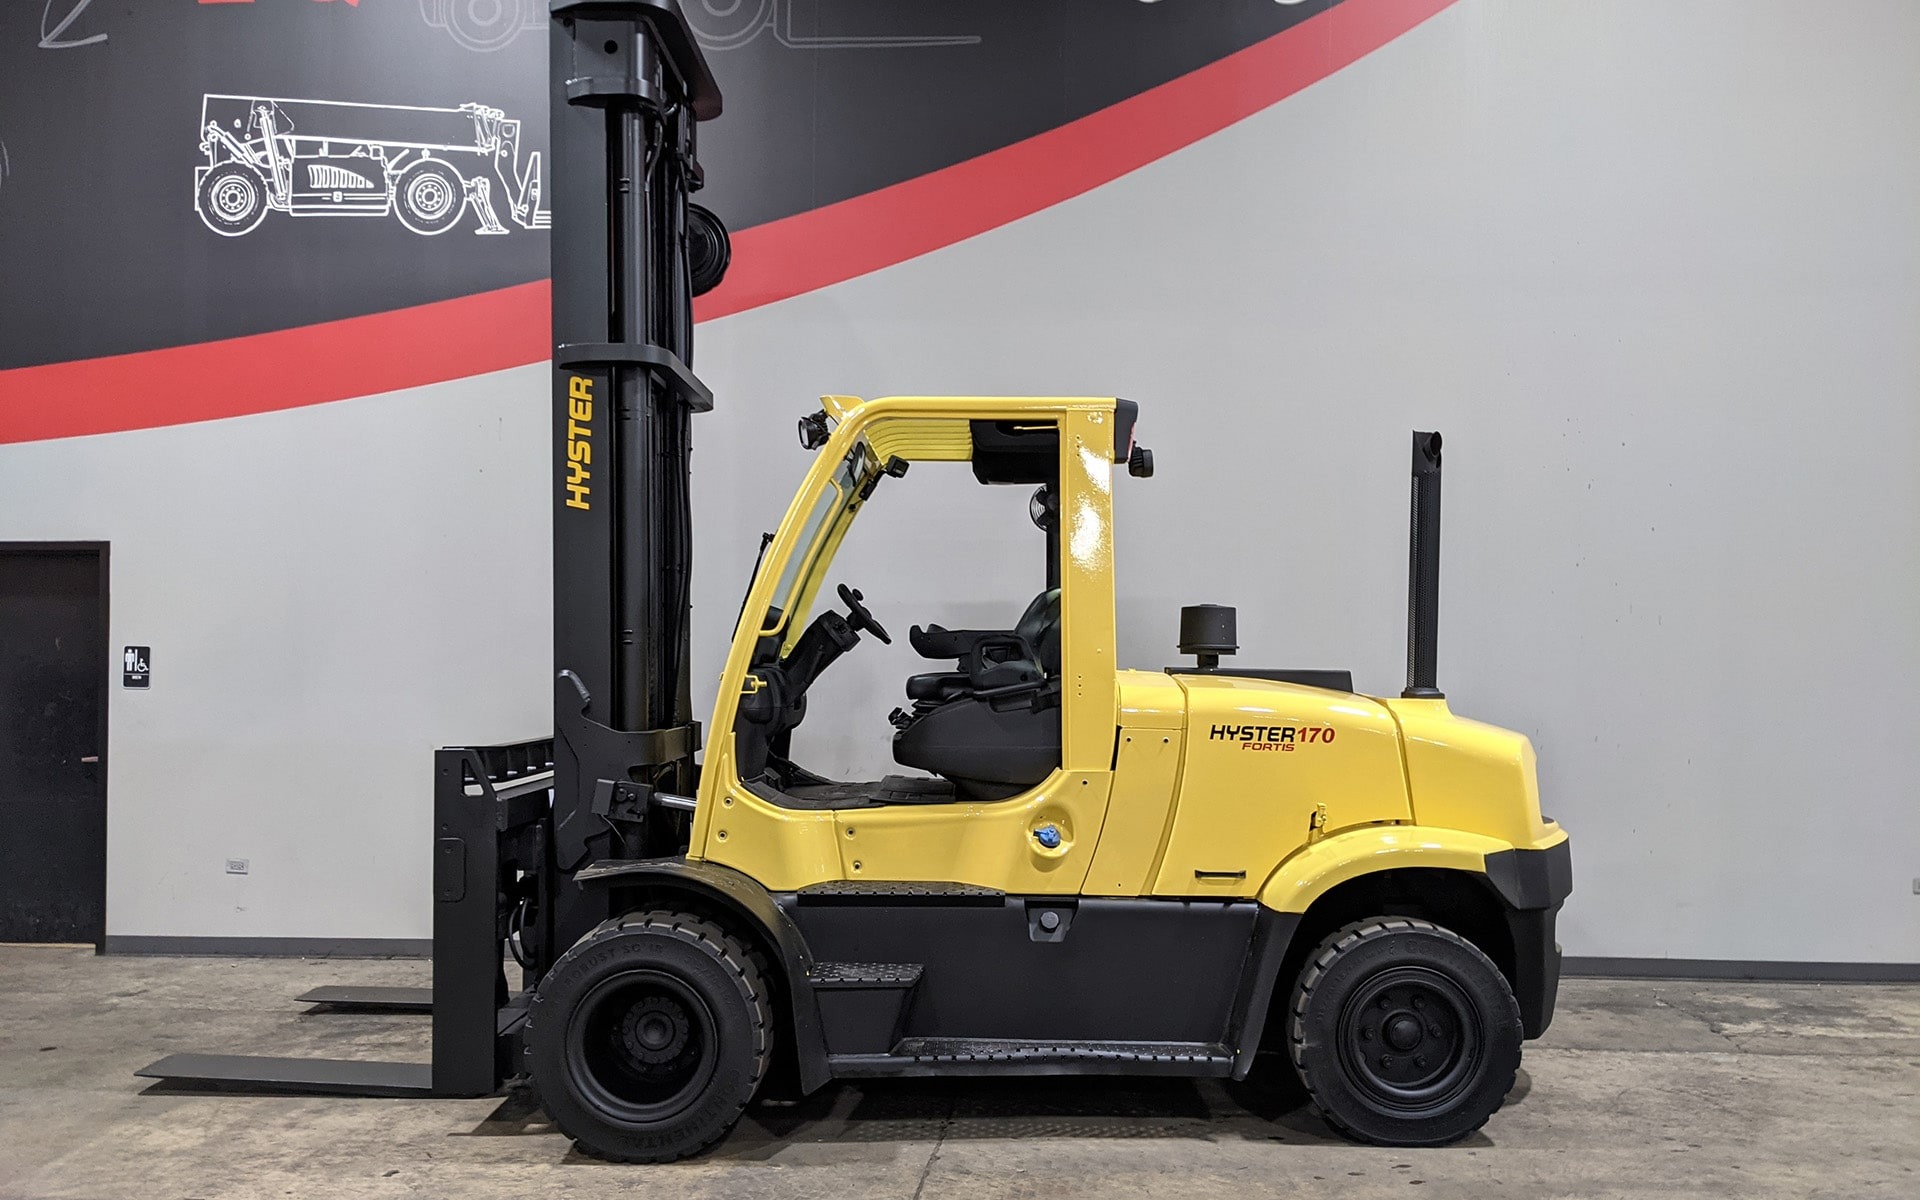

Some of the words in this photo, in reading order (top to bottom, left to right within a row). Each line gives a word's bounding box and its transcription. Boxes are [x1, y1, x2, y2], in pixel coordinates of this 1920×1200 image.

[566, 376, 593, 510] HYSTER
[1209, 724, 1296, 742] HYSTER
[1297, 727, 1336, 743] 170
[1242, 742, 1295, 752] FORTIS
